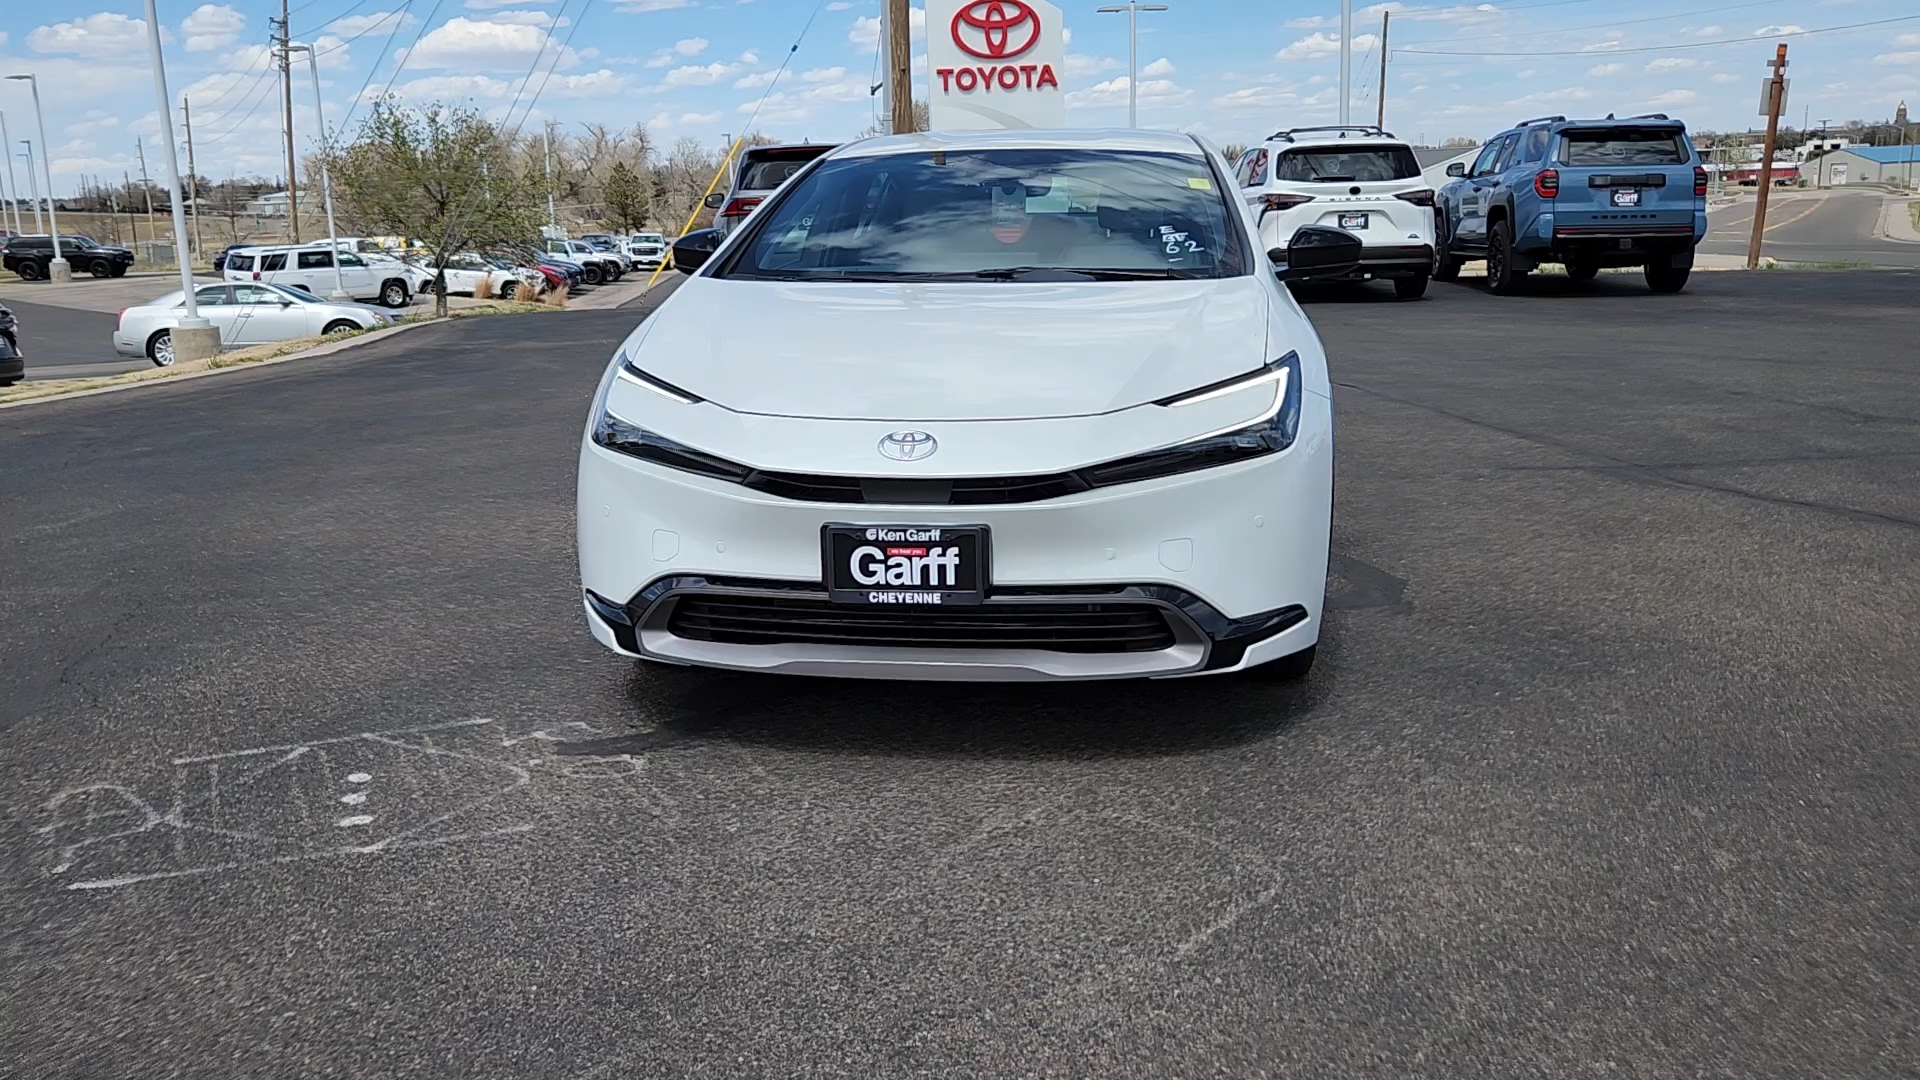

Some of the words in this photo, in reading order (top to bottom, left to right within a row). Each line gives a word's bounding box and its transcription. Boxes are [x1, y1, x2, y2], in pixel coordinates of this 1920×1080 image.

[936, 64, 1058, 92] TOYOTA
[1613, 193, 1638, 203] Garff
[1341, 216, 1365, 227] Garff
[878, 529, 905, 542] Ken
[906, 529, 941, 542] Garff
[850, 545, 960, 586] Garff
[869, 592, 942, 604] CHEYENNE
